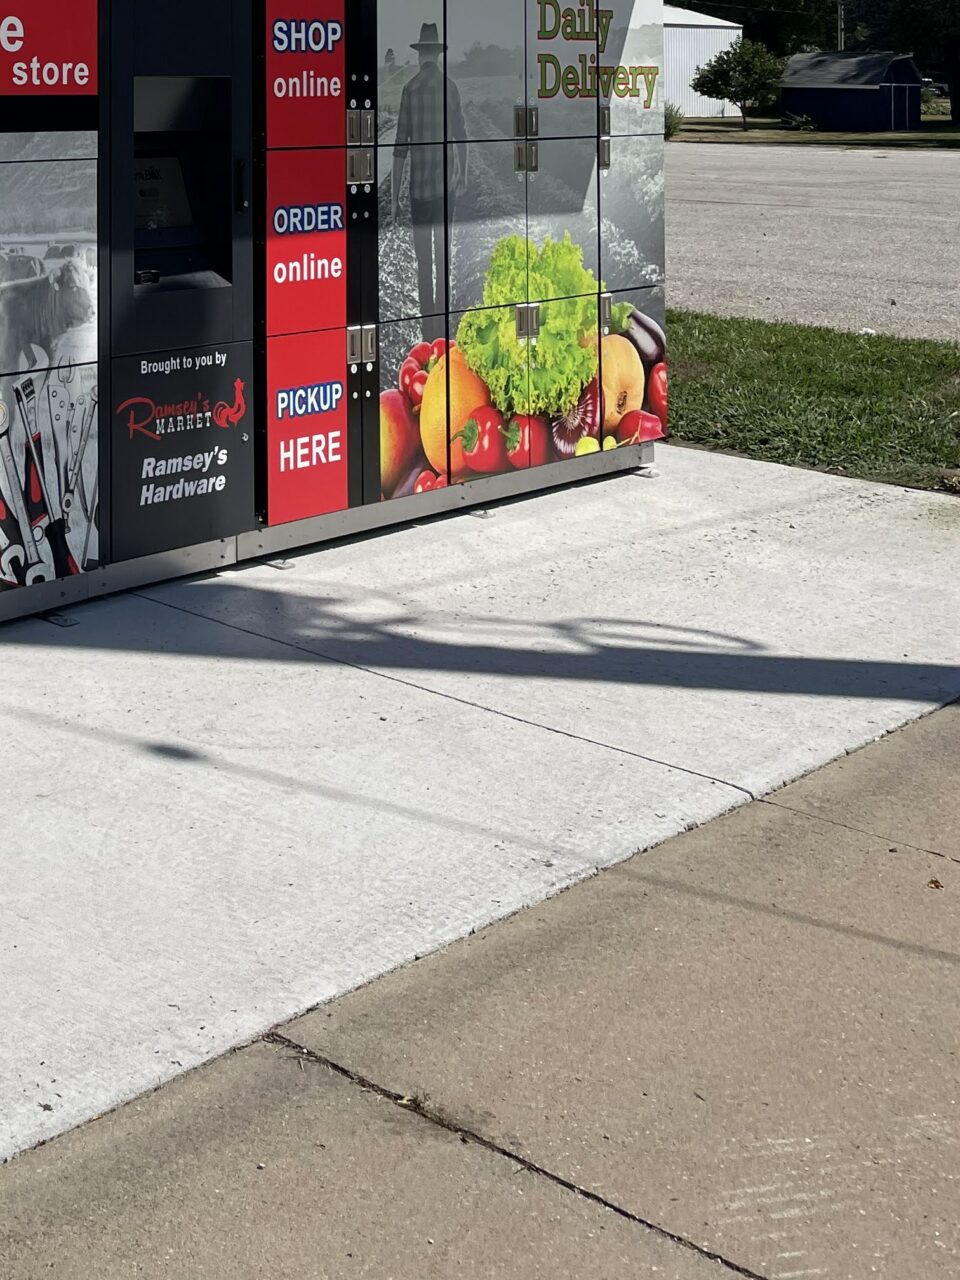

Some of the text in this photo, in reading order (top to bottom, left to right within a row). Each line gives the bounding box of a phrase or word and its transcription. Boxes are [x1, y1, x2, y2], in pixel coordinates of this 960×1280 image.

[273, 20, 343, 51] SHOP
[12, 56, 89, 86] store
[273, 71, 341, 98] online
[537, 53, 659, 109] Delivery
[273, 205, 343, 233] ORDER
[273, 253, 343, 283] online
[141, 351, 227, 374] Brought to you by
[116, 392, 210, 441] Ramsey's
[277, 383, 343, 419] PICKUP
[155, 412, 212, 435] MARKET
[141, 446, 228, 478] Ramsey's
[279, 430, 341, 472] HERE
[140, 474, 226, 505] Hardware
